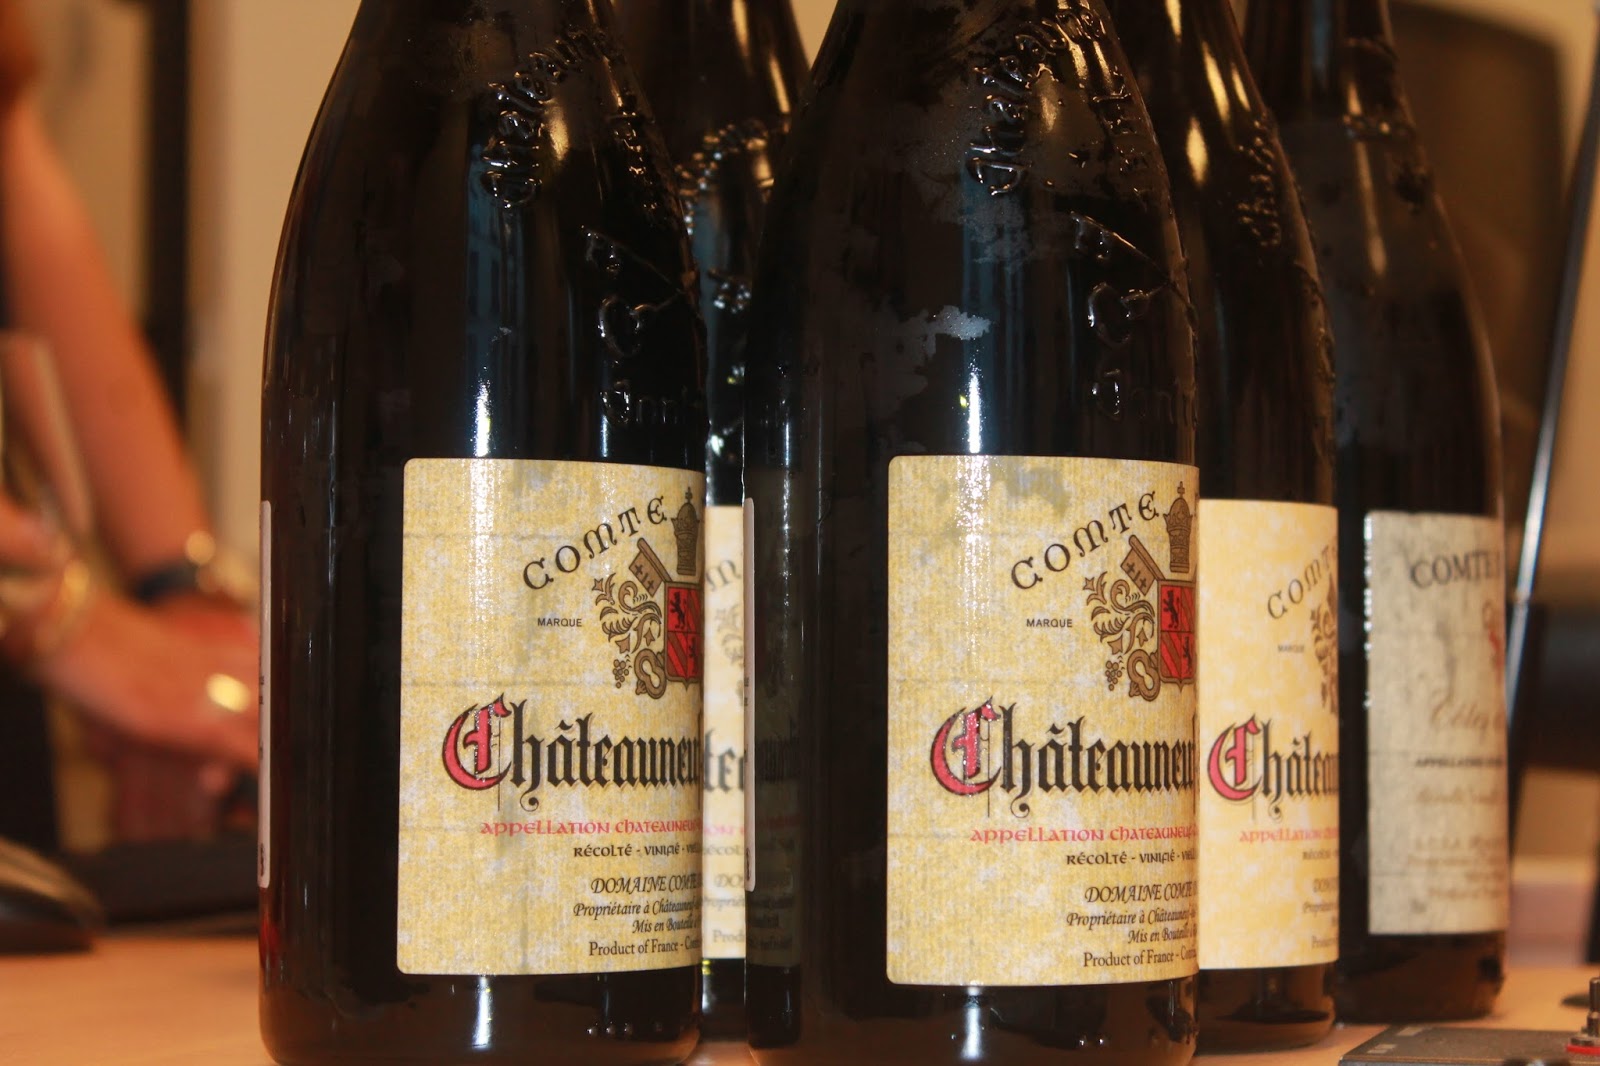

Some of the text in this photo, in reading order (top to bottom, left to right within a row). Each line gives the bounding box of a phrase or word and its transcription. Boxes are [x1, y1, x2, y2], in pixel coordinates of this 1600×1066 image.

[523, 495, 668, 590] COMTE
[1011, 490, 1159, 590] COMTE
[1267, 544, 1336, 620] COMT
[537, 616, 583, 628] MARQUE
[1026, 617, 1074, 629] MARQUE
[442, 692, 702, 812] Châteauneu
[573, 844, 633, 858] RÉCOLTÉ
[1066, 850, 1128, 865] RÉCOLTÉ
[1139, 849, 1175, 864] VINIFIÉ
[590, 875, 667, 895] DOMAINE
[1084, 883, 1162, 904] DOMAINE
[573, 900, 641, 921] Propriétaire
[643, 902, 650, 914] à
[1066, 910, 1137, 931] Propriétaire
[1139, 909, 1145, 924] à
[631, 918, 652, 934] Mis
[654, 921, 665, 932] en
[1127, 929, 1148, 944] Mis
[1150, 932, 1160, 942] en
[589, 940, 634, 957] Product
[637, 939, 649, 954] of
[651, 937, 679, 954] France
[1083, 950, 1131, 968] Product
[1133, 949, 1146, 965] of
[1147, 948, 1175, 965] France
